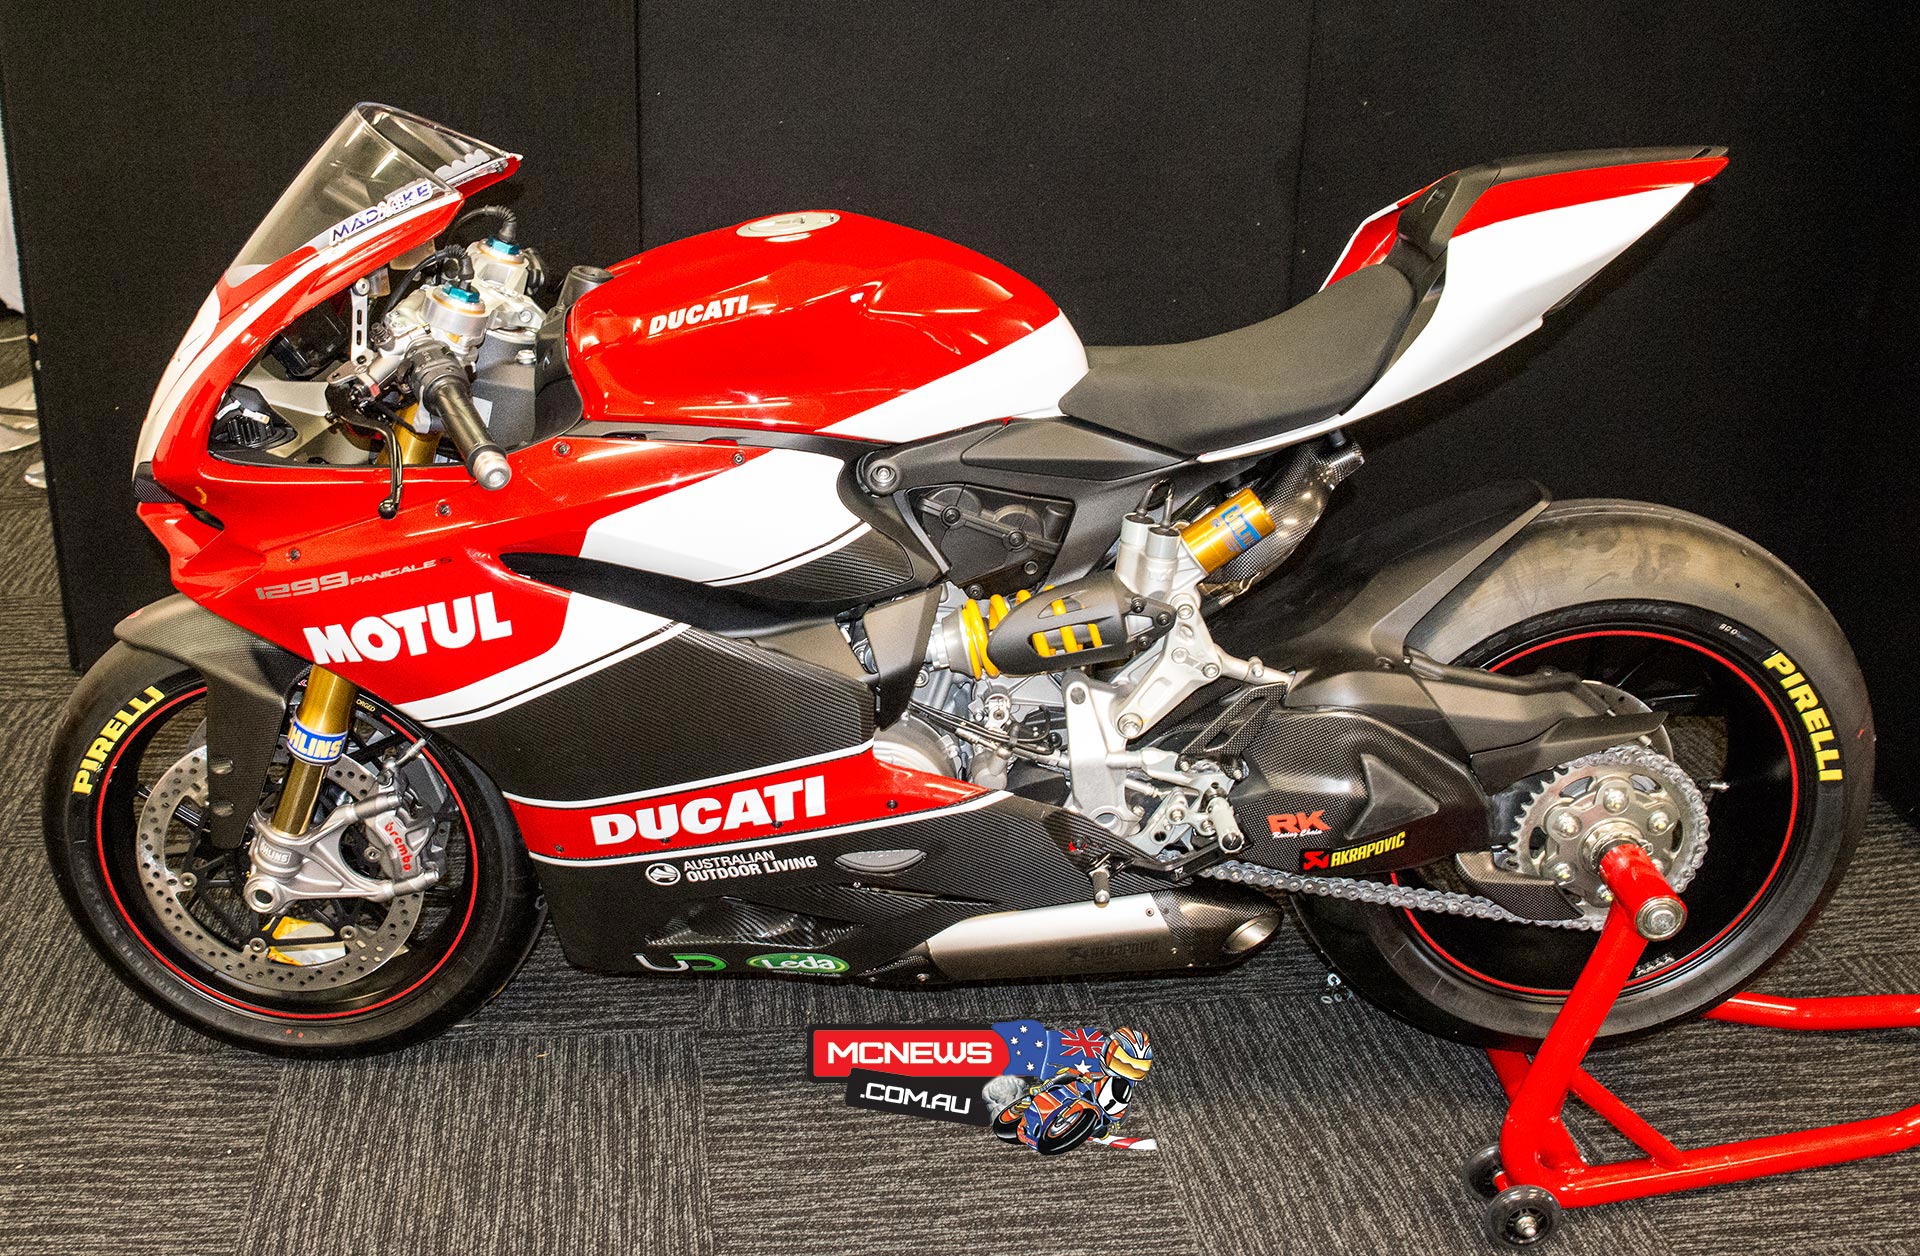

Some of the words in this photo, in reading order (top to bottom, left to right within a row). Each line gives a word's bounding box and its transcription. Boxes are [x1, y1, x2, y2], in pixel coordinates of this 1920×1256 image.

[648, 294, 749, 336] DUCATI
[255, 571, 350, 600] 1299
[350, 559, 437, 586] PANIGALE
[303, 591, 513, 665] MOTUL
[355, 699, 377, 713] ORGED
[1762, 651, 1843, 782] PIRELLI
[72, 685, 166, 795] PIRELLI
[287, 725, 343, 759] HLINS
[590, 775, 827, 845] DUCATI
[1267, 809, 1331, 833] RK
[384, 821, 414, 872] brembo
[683, 850, 776, 872] AUSTRALIAN
[1330, 831, 1406, 868] AKRAPOVIC
[685, 863, 762, 883] OUTDOOR
[763, 855, 818, 874] LIVING
[761, 955, 837, 970] Leda
